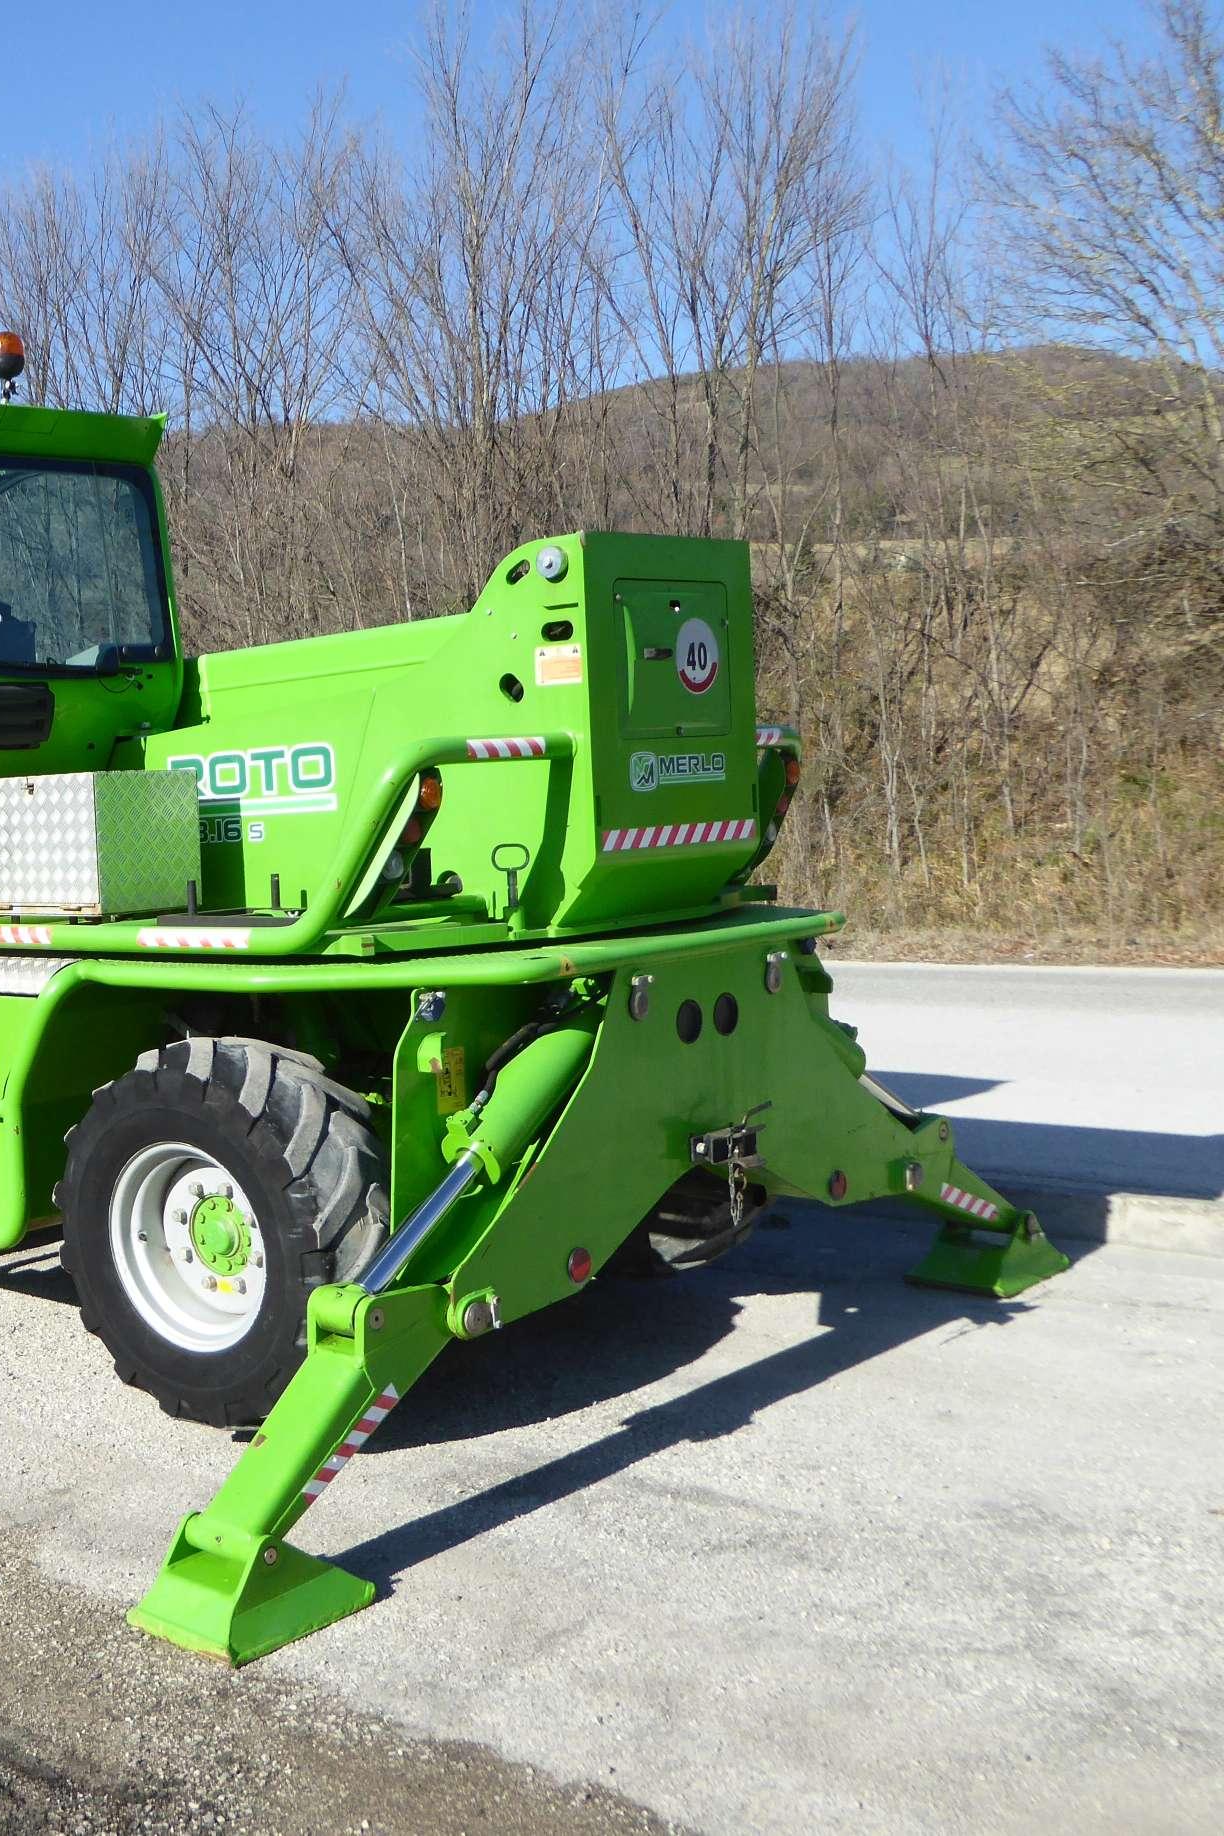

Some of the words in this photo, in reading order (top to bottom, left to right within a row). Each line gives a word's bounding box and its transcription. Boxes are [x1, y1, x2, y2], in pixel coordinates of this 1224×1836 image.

[686, 641, 708, 671] 40
[169, 745, 333, 796] ROTO
[659, 754, 725, 774] MERLO
